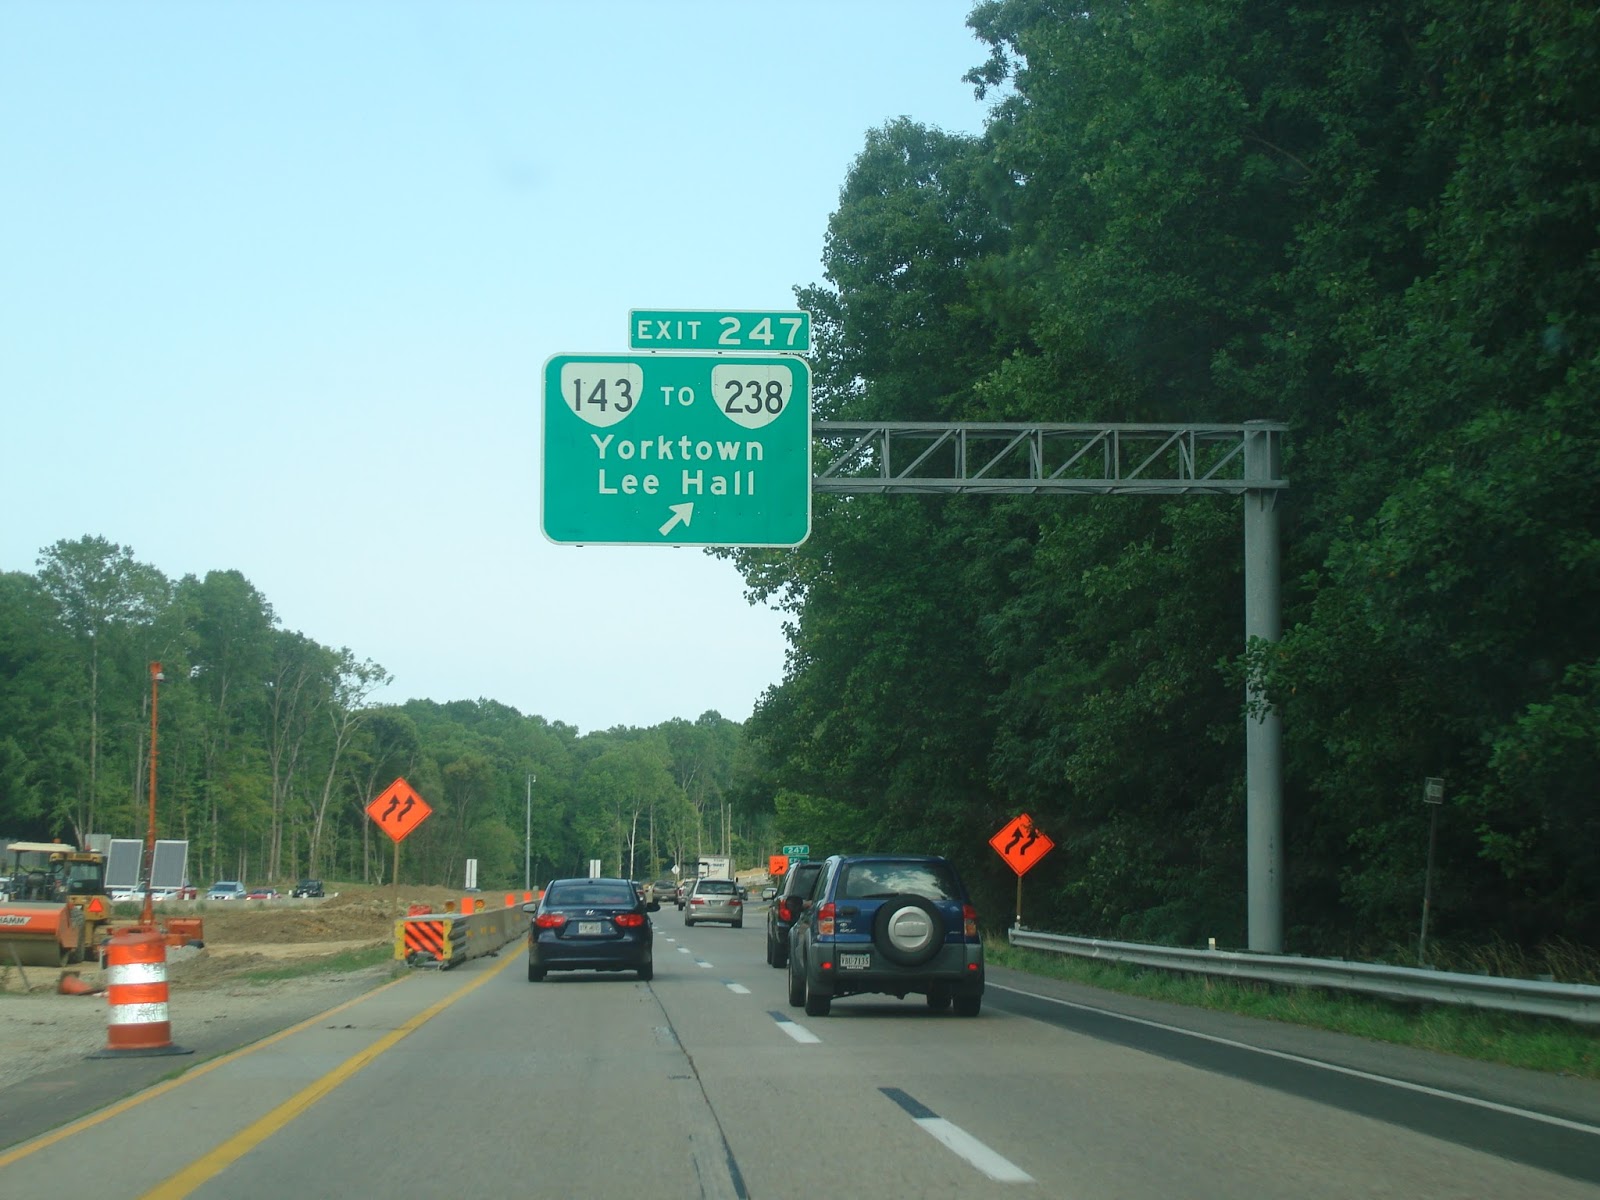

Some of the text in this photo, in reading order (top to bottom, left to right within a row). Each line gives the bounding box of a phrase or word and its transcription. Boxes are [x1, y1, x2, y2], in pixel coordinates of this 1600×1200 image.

[638, 316, 802, 345] EXIT 247
[573, 378, 783, 414] 143 TO 238
[590, 433, 764, 461] Yorktown
[599, 469, 754, 495] Lee Hall
[788, 846, 805, 854] 247
